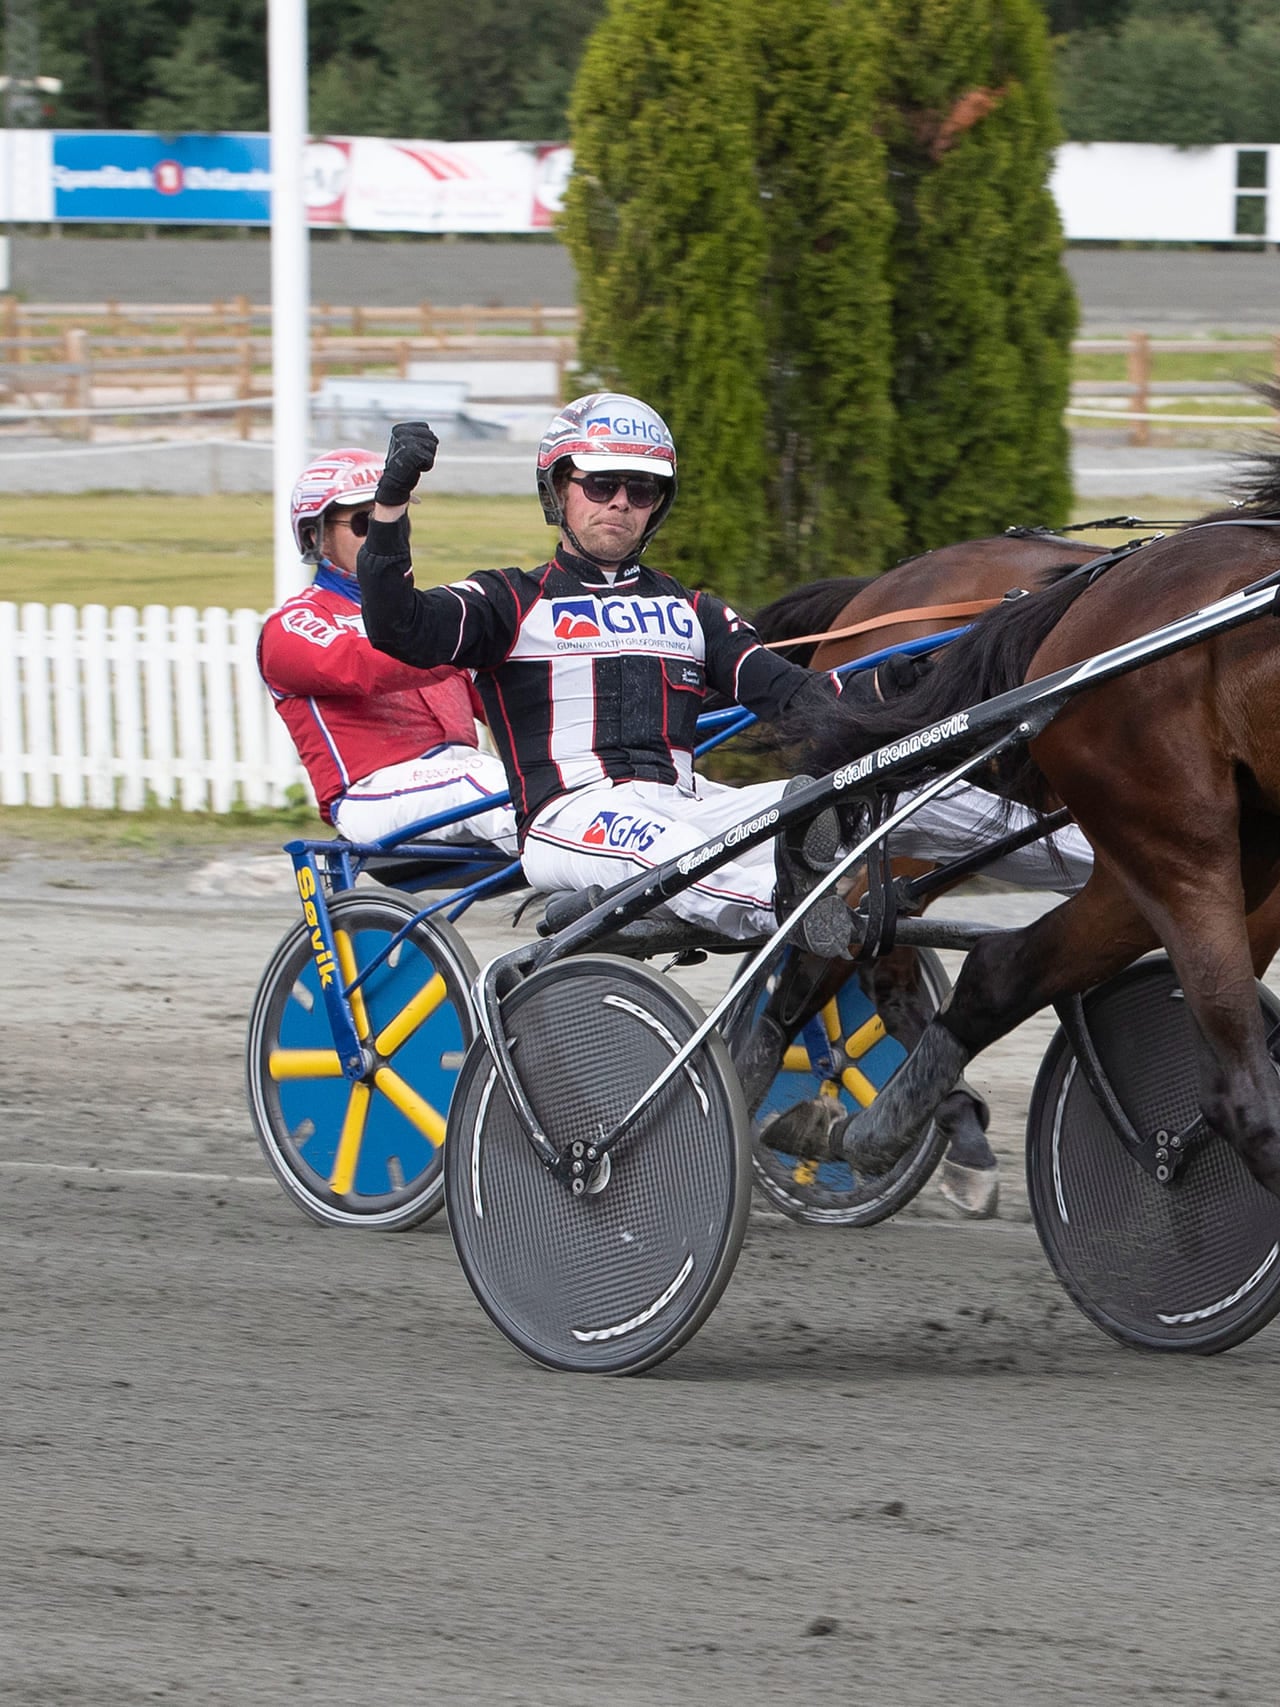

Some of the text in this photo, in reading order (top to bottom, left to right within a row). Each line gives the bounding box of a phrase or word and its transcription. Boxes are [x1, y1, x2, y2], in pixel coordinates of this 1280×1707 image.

[613, 417, 662, 444] GHG
[602, 601, 693, 639] GHG
[557, 641, 593, 651] GUNNAR
[833, 713, 969, 789] Stall Rennesvik
[609, 815, 666, 852] GHG
[725, 809, 779, 847] Chrono
[297, 866, 336, 990] Søvik
